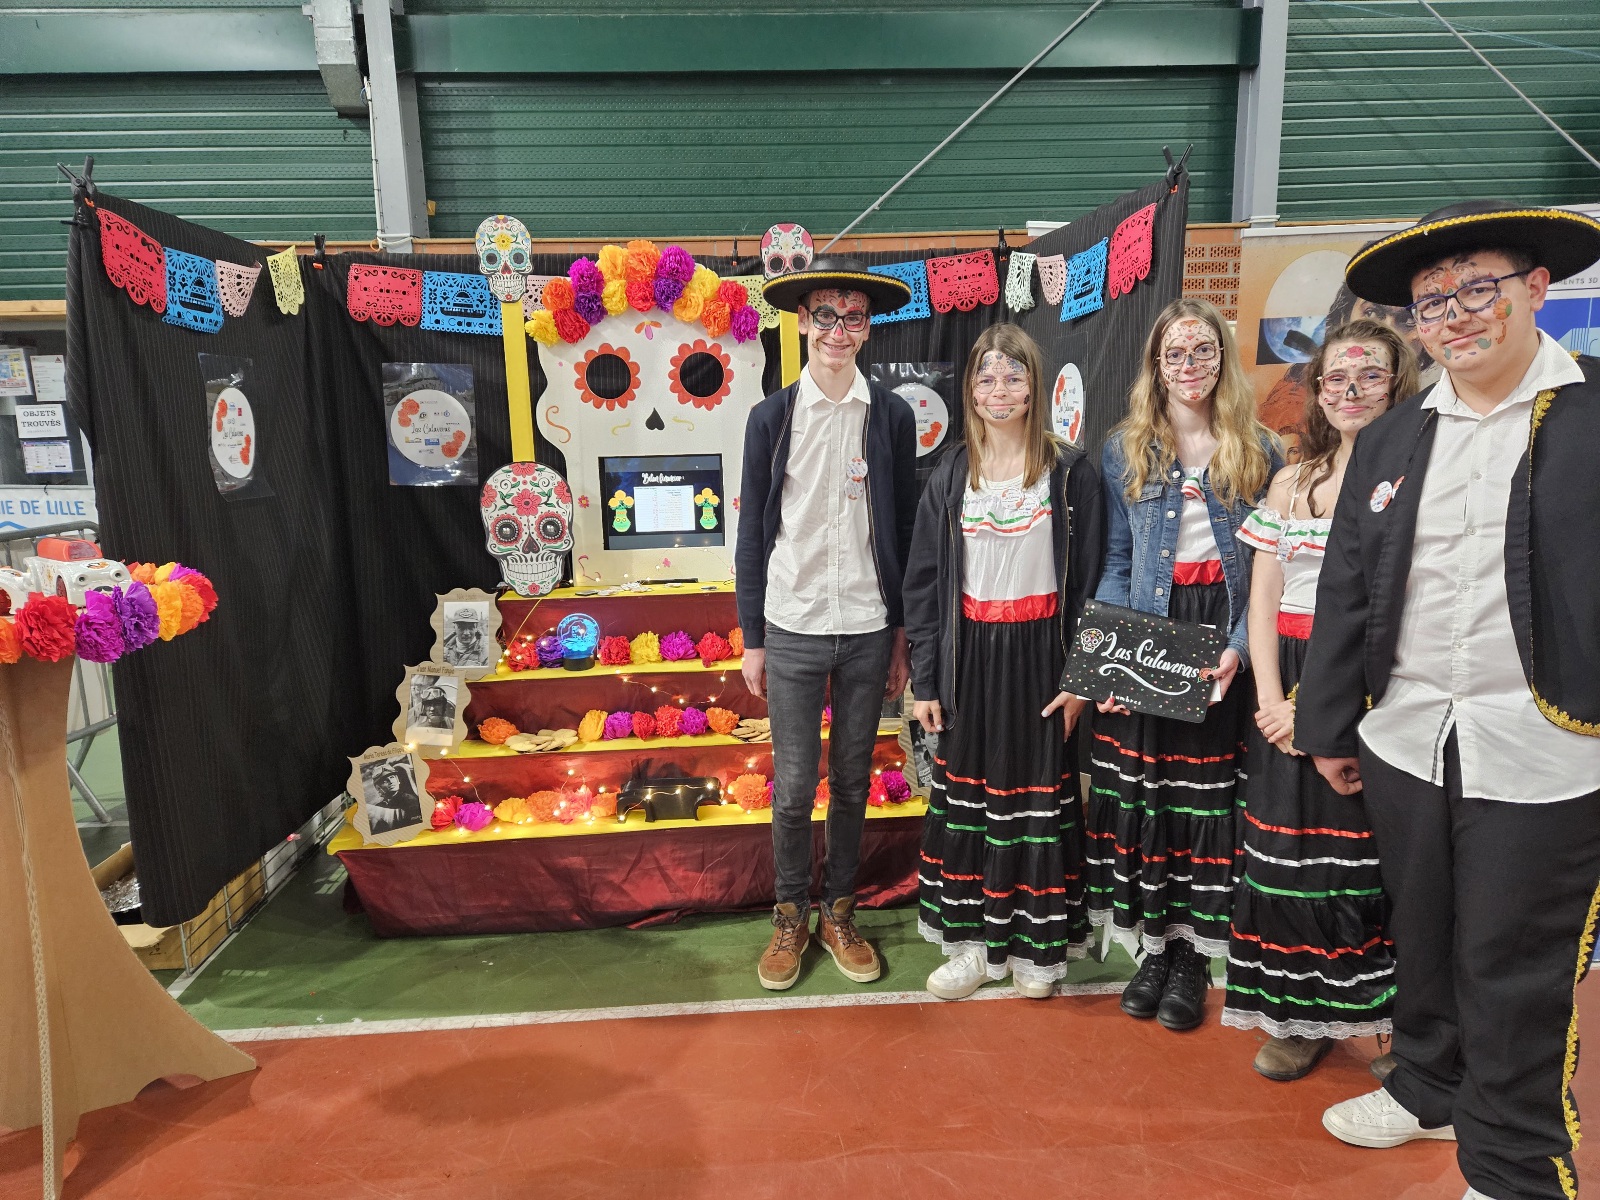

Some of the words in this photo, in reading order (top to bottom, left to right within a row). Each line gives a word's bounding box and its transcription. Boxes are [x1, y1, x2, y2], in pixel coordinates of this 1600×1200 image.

[952, 272, 986, 282] Calaveras
[373, 286, 410, 296] Calaveras
[430, 316, 444, 324] Las
[448, 318, 498, 328] Calaveras
[21, 419, 61, 427] TROUVÉS
[0, 501, 14, 514] IE
[20, 500, 40, 515] DE
[47, 500, 86, 515] LILLE
[1101, 632, 1132, 661] Las
